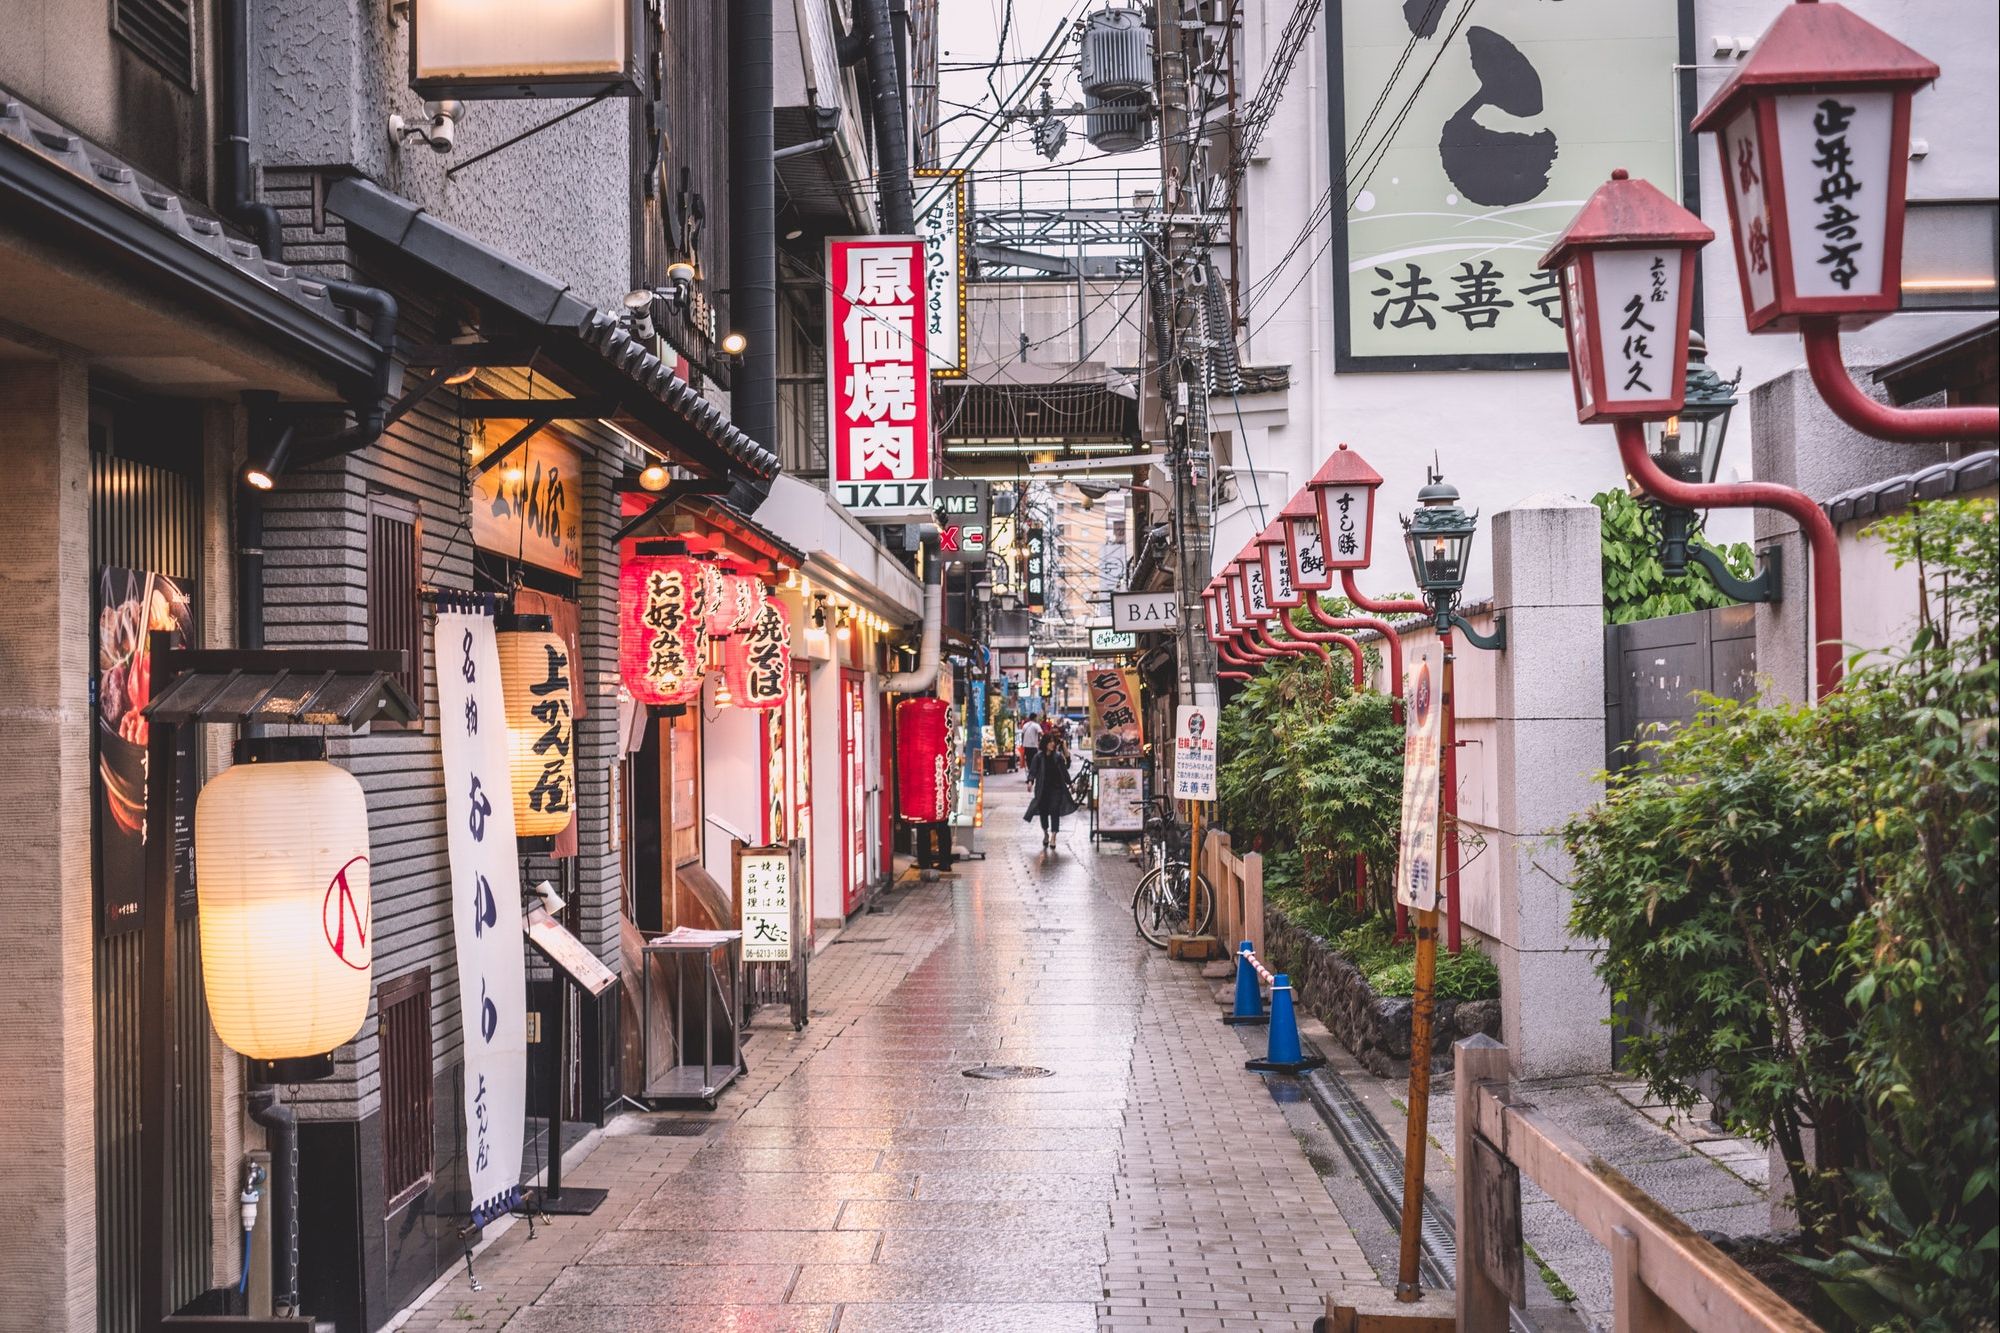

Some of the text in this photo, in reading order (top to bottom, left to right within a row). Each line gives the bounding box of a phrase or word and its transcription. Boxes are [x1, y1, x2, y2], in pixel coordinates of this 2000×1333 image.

[1371, 260, 1565, 331] 法善寺
[842, 247, 917, 481] 原価焼肉
[1621, 294, 1655, 392] 久佐久
[838, 483, 928, 508] コスコス
[933, 497, 978, 513] AME
[1336, 493, 1358, 555] すし勝
[1128, 602, 1176, 622] BAR
[746, 606, 783, 698] 焼そば
[462, 628, 478, 738] 名物
[1092, 672, 1135, 730] もつ鍋
[528, 642, 572, 813] 上かん屋
[1179, 781, 1210, 794] 法善寺
[747, 864, 758, 908] 一品料理
[746, 948, 788, 958] 06-6213-1888
[754, 918, 787, 942] 大たこ
